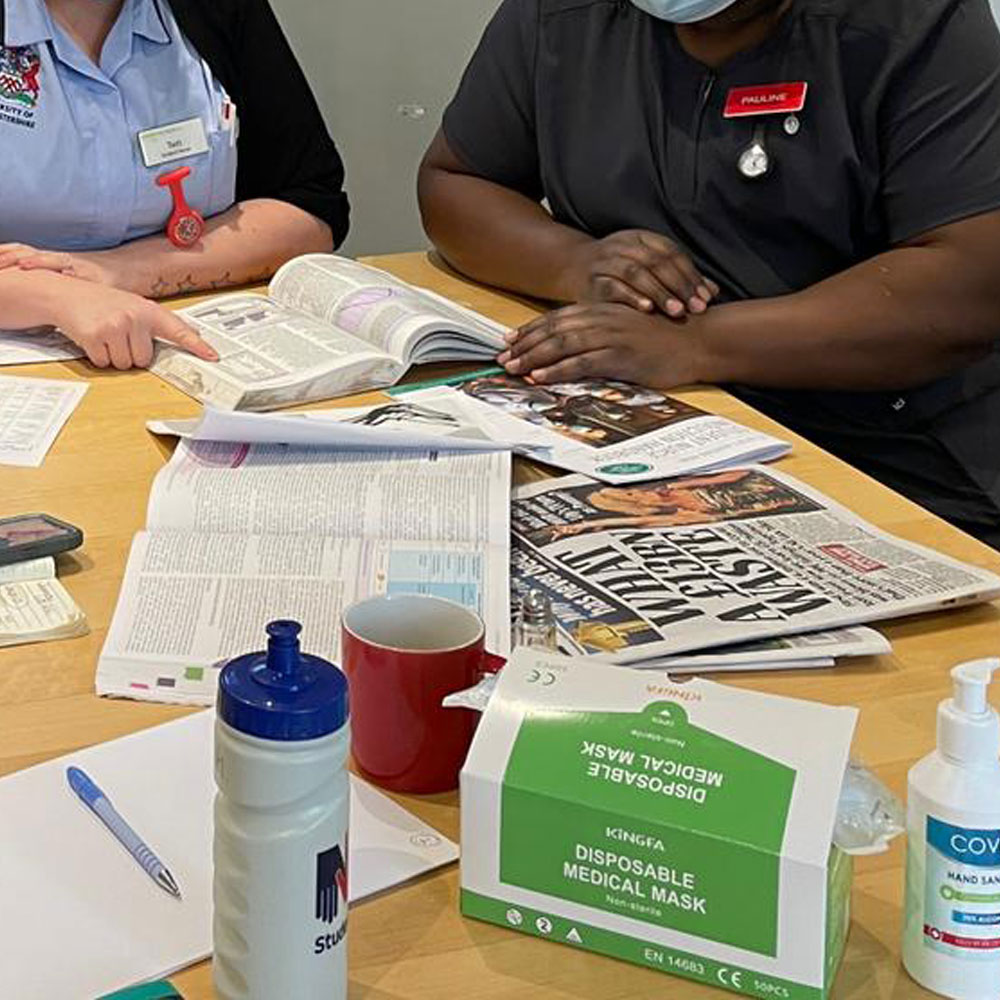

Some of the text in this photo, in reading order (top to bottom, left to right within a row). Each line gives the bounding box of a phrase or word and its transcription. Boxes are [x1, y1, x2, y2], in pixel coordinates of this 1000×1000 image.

[741, 93, 788, 106] PAULINE
[553, 544, 705, 628] WHAT
[660, 527, 833, 617] WASTE
[716, 602, 790, 622] A
[580, 740, 724, 788] MEDICAL MASK
[587, 761, 708, 804] DISPOSABLE
[950, 834, 1000, 856] COV
[575, 843, 695, 890] DISPOSABLE
[948, 871, 979, 884] HAND
[563, 861, 707, 915] MEDICAL MASK
[606, 894, 662, 917] Non-sterile
[644, 948, 706, 976] EN 14683
